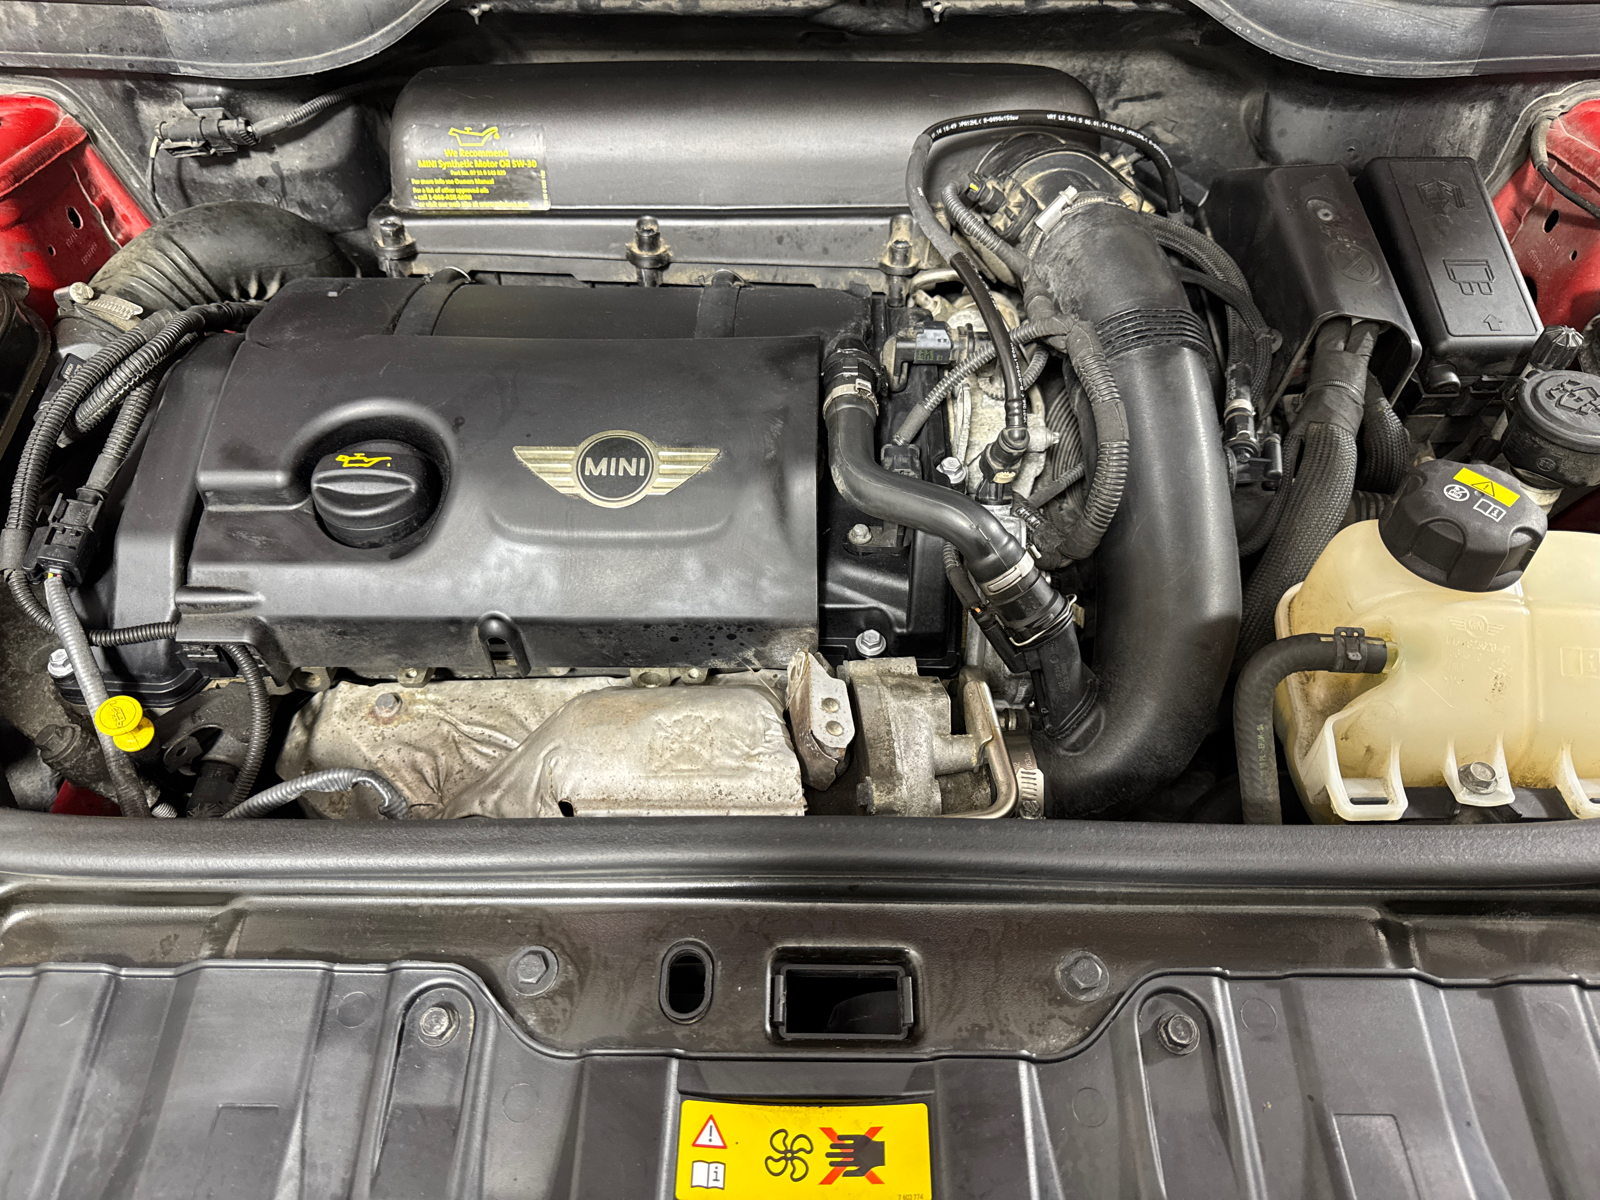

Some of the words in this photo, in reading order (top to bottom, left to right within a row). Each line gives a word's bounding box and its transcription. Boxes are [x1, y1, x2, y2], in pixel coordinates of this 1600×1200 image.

[444, 148, 458, 157] We
[459, 147, 509, 157] Recommend
[417, 159, 437, 168] MINI
[438, 159, 474, 170] Synthetic
[474, 159, 498, 168] Motor
[499, 159, 511, 168] Oil
[511, 159, 537, 168] 5W-30
[585, 457, 646, 476] MINI
